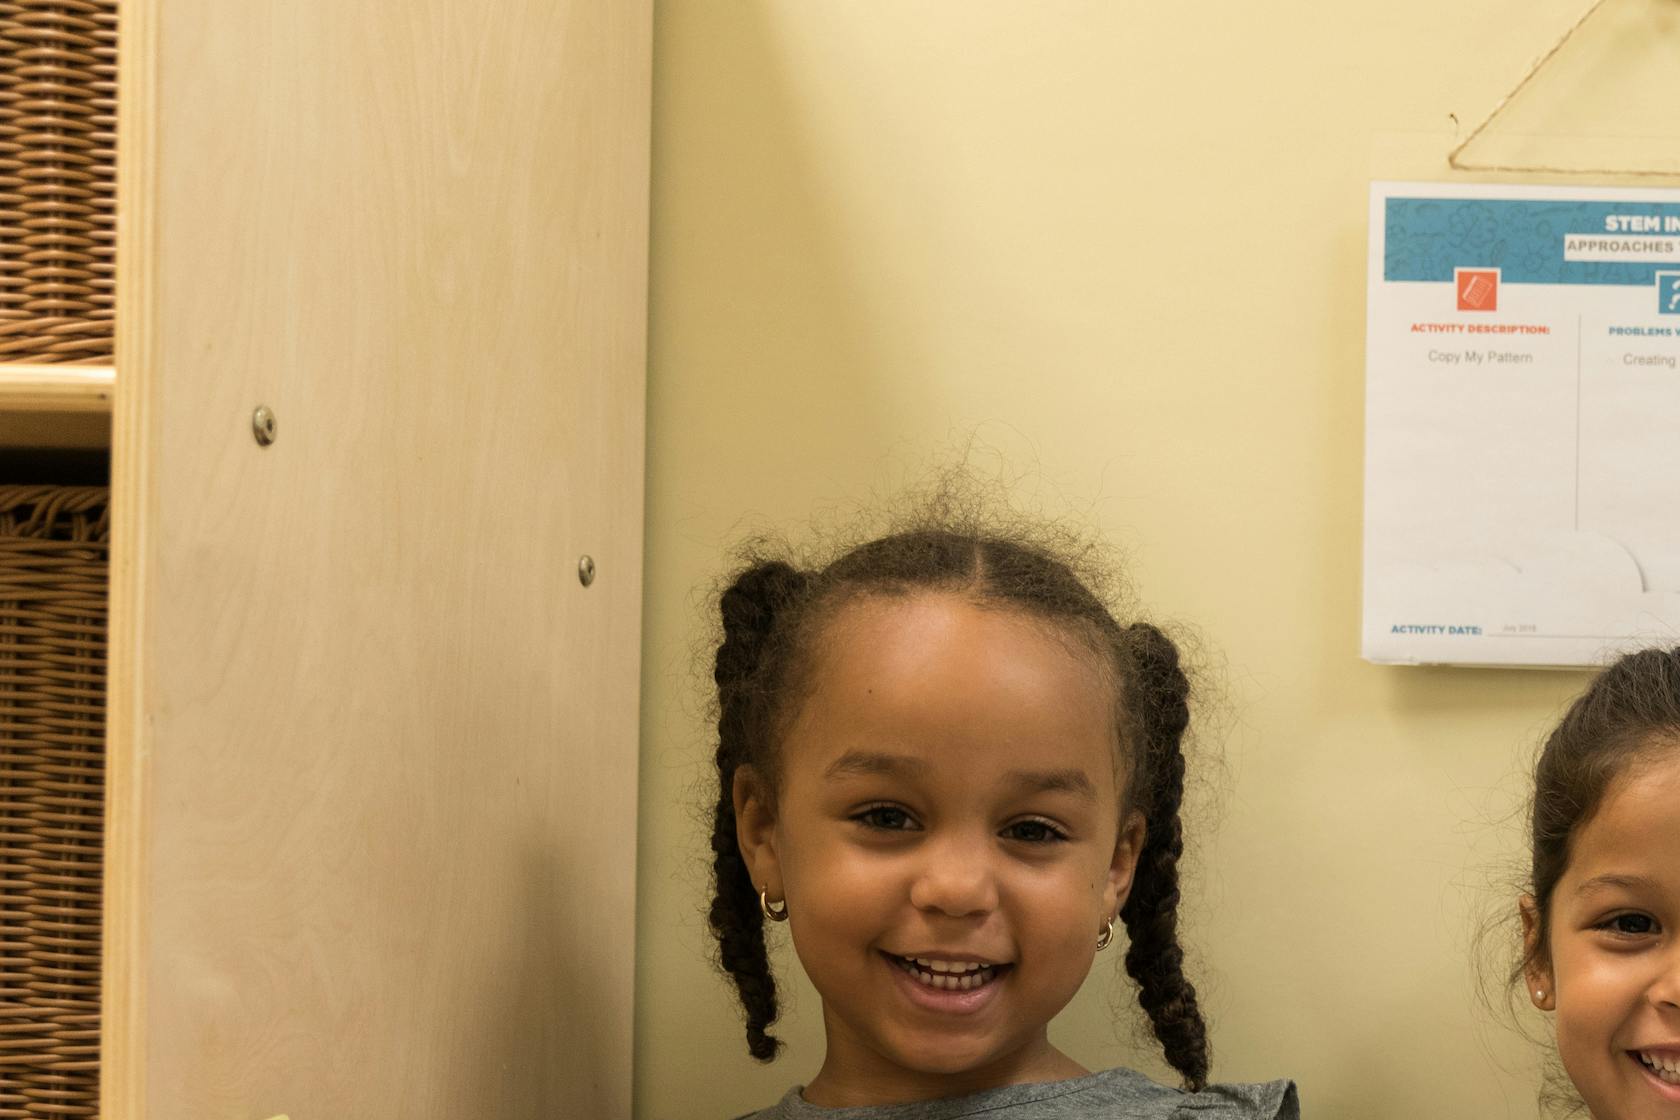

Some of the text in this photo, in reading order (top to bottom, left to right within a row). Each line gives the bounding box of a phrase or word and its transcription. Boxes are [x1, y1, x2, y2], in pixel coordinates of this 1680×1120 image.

[1605, 215, 1660, 232] STEM
[1567, 239, 1674, 253] APPROACHES
[1411, 323, 1550, 335] ACTIVITY DESCRIPTION:
[1608, 326, 1672, 337] PROBLEMS
[1428, 350, 1533, 364] Copy My Pattern
[1623, 353, 1676, 368] Creating
[1391, 624, 1482, 635] ACTIVITY DATE:
